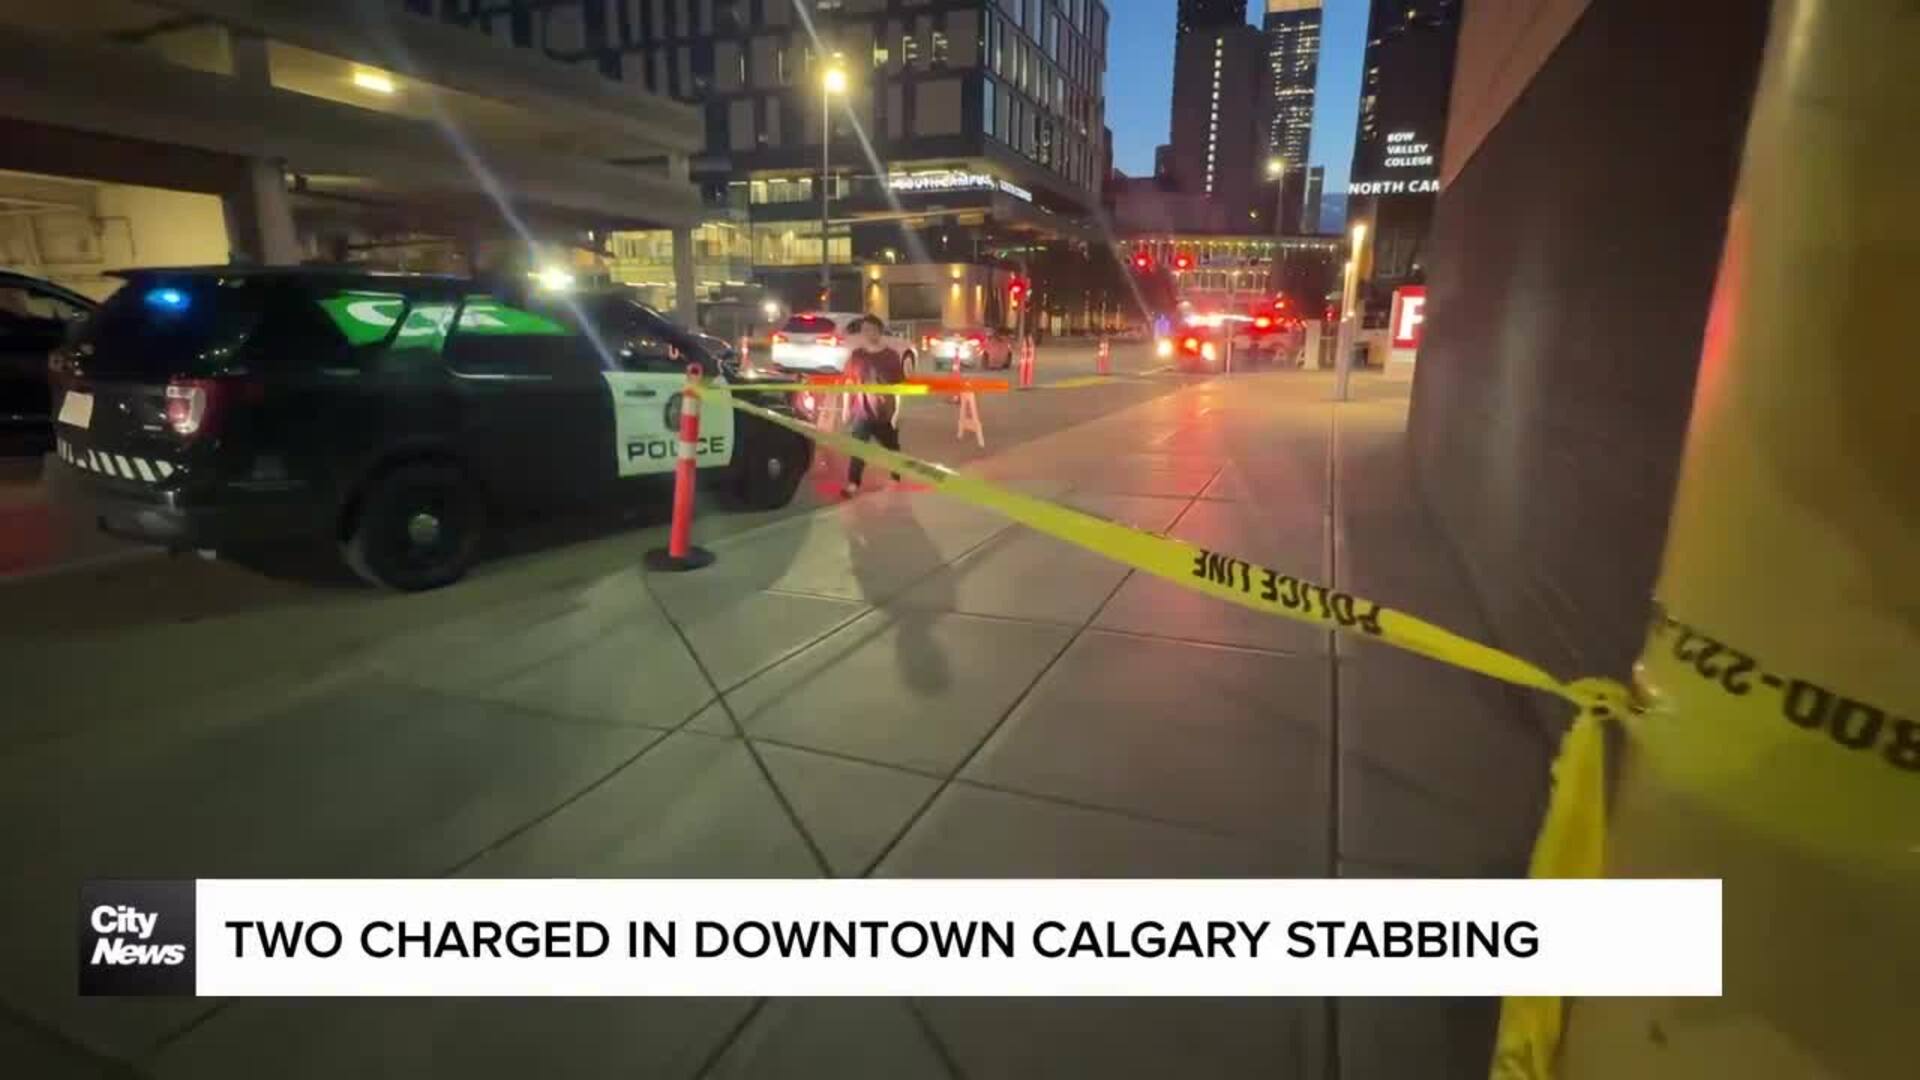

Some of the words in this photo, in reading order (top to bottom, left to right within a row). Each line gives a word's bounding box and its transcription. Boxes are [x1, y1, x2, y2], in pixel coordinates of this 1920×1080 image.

[1387, 131, 1415, 143] BOW
[1386, 144, 1429, 154] VALLEY
[1383, 156, 1434, 168] COLLEGE
[1348, 181, 1404, 194] NORTH
[1192, 549, 1250, 593] LINE
[1261, 568, 1383, 635] POLICE
